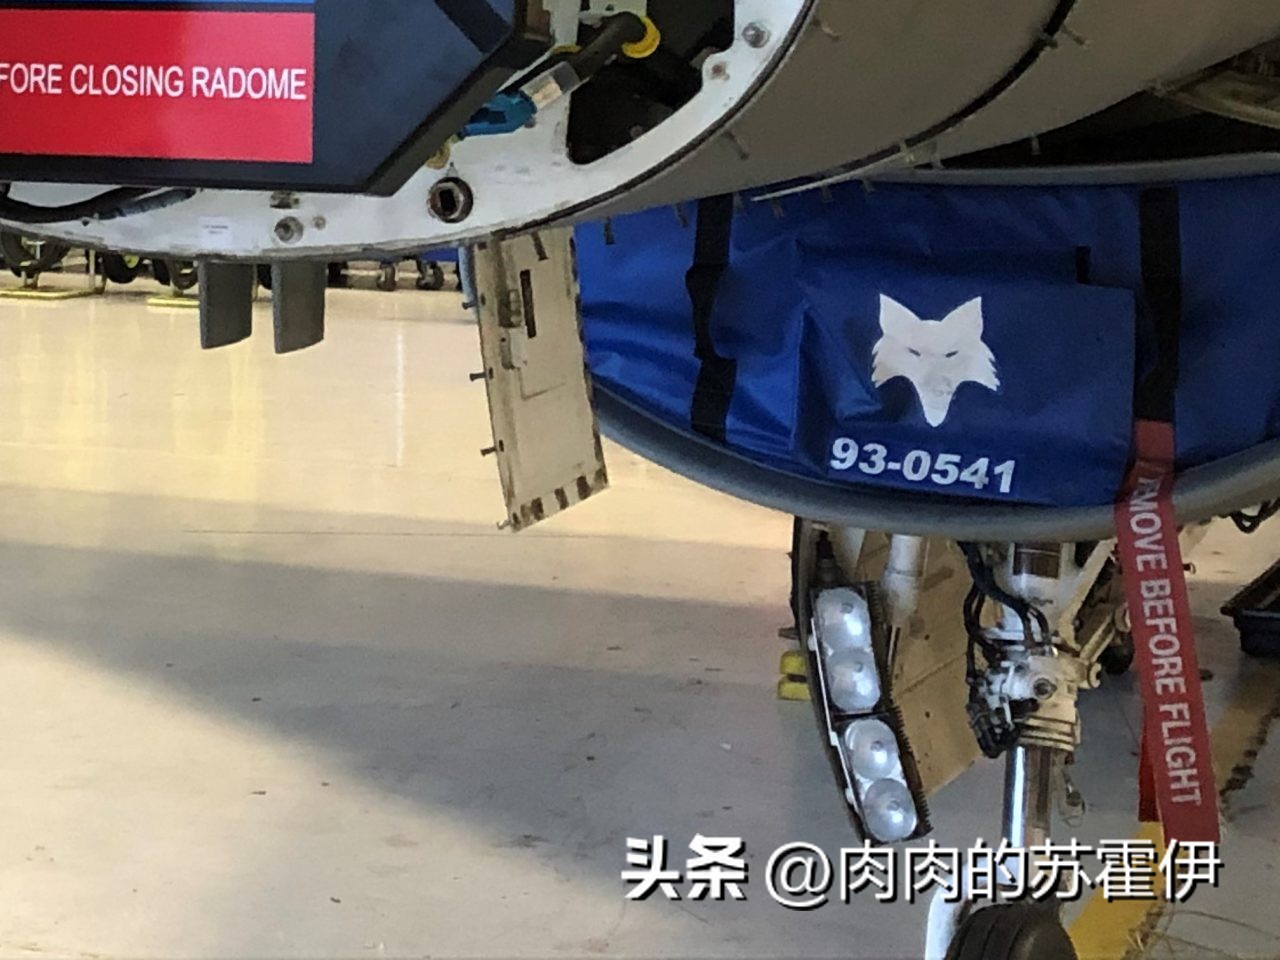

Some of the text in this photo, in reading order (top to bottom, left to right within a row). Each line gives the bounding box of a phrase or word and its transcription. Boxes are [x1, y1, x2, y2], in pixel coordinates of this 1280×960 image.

[70, 63, 184, 98] CLOSING
[192, 66, 307, 100] RADOME
[830, 437, 1016, 493] 93-0541
[1140, 577, 1187, 695] BEFORE
[1159, 701, 1202, 806] FLIGHT
